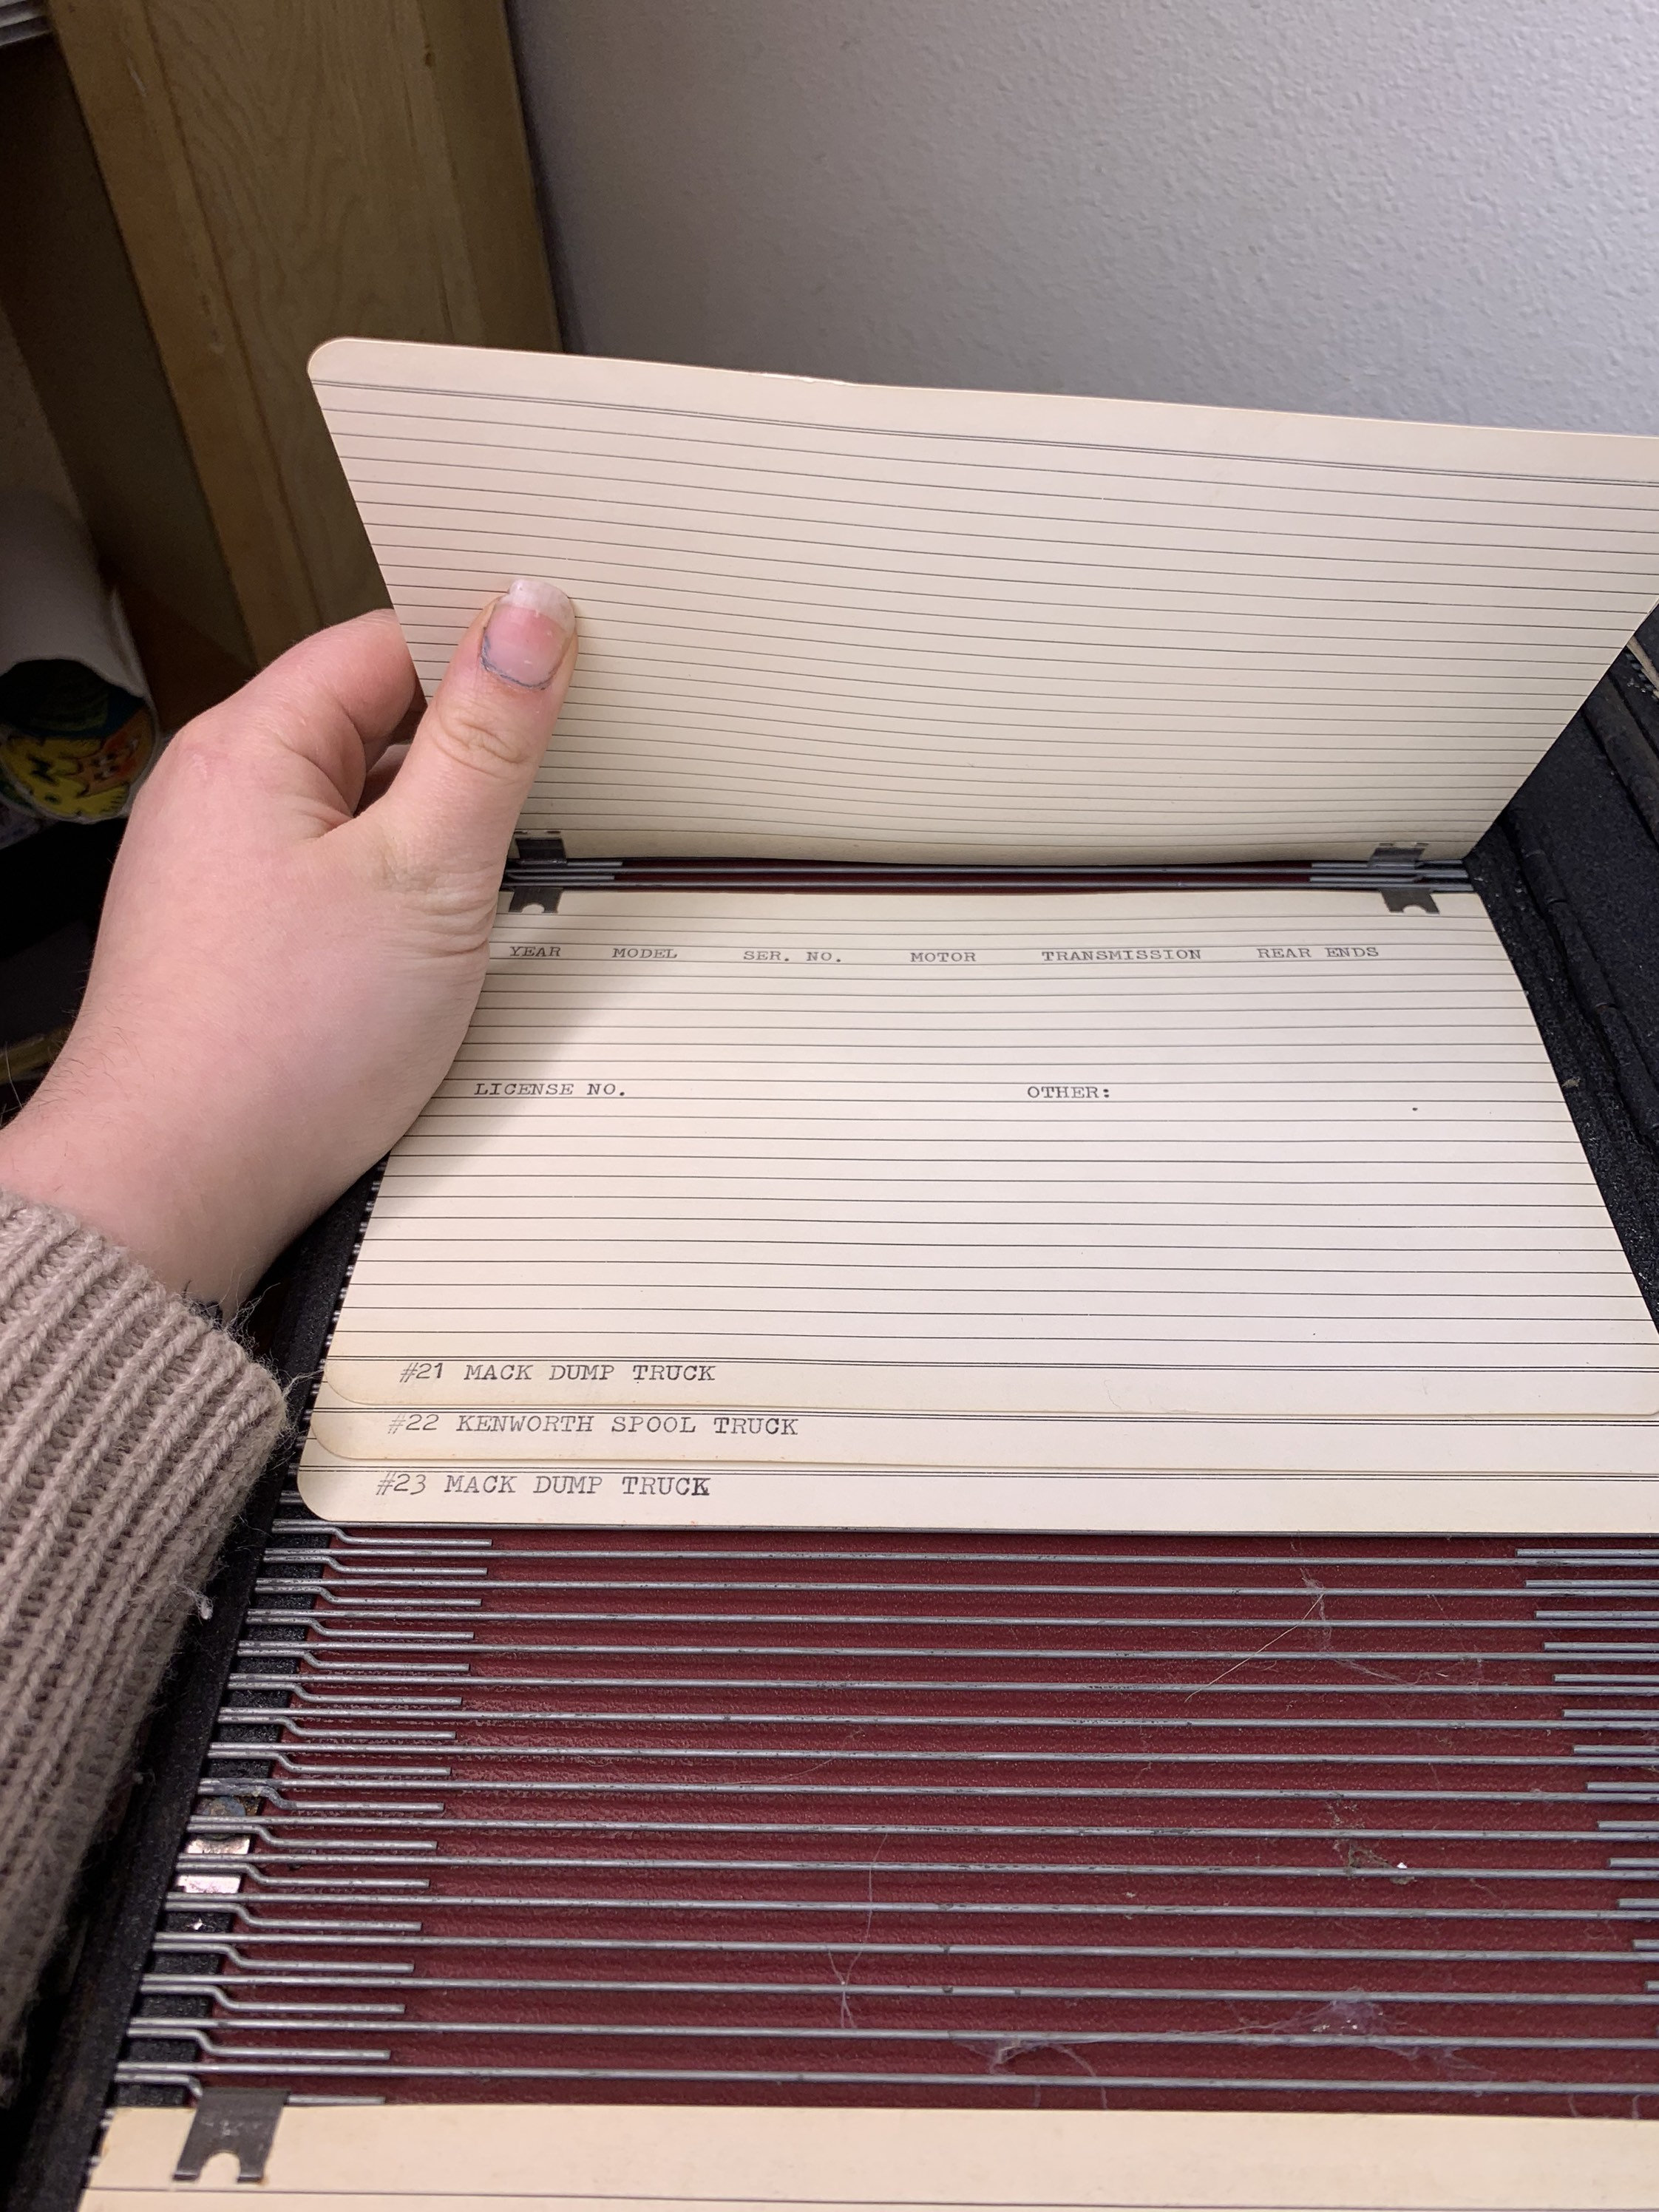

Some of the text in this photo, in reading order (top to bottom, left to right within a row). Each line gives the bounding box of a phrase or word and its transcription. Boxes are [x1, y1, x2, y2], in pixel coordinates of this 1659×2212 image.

[509, 946, 1380, 963] YEAR MODEL SER. NO. MOTOR TRANSMISSION REAR ENDS
[474, 1082, 627, 1097] LICENSE NO.
[1027, 1085, 1110, 1099] OTHER:
[399, 1362, 716, 1382] #21 MACK DUMP TRUCK
[387, 1413, 799, 1436] #22 KENWORTH SPOOL TRUCK
[376, 1473, 711, 1496] #23 MACK DUMP TRUCK
